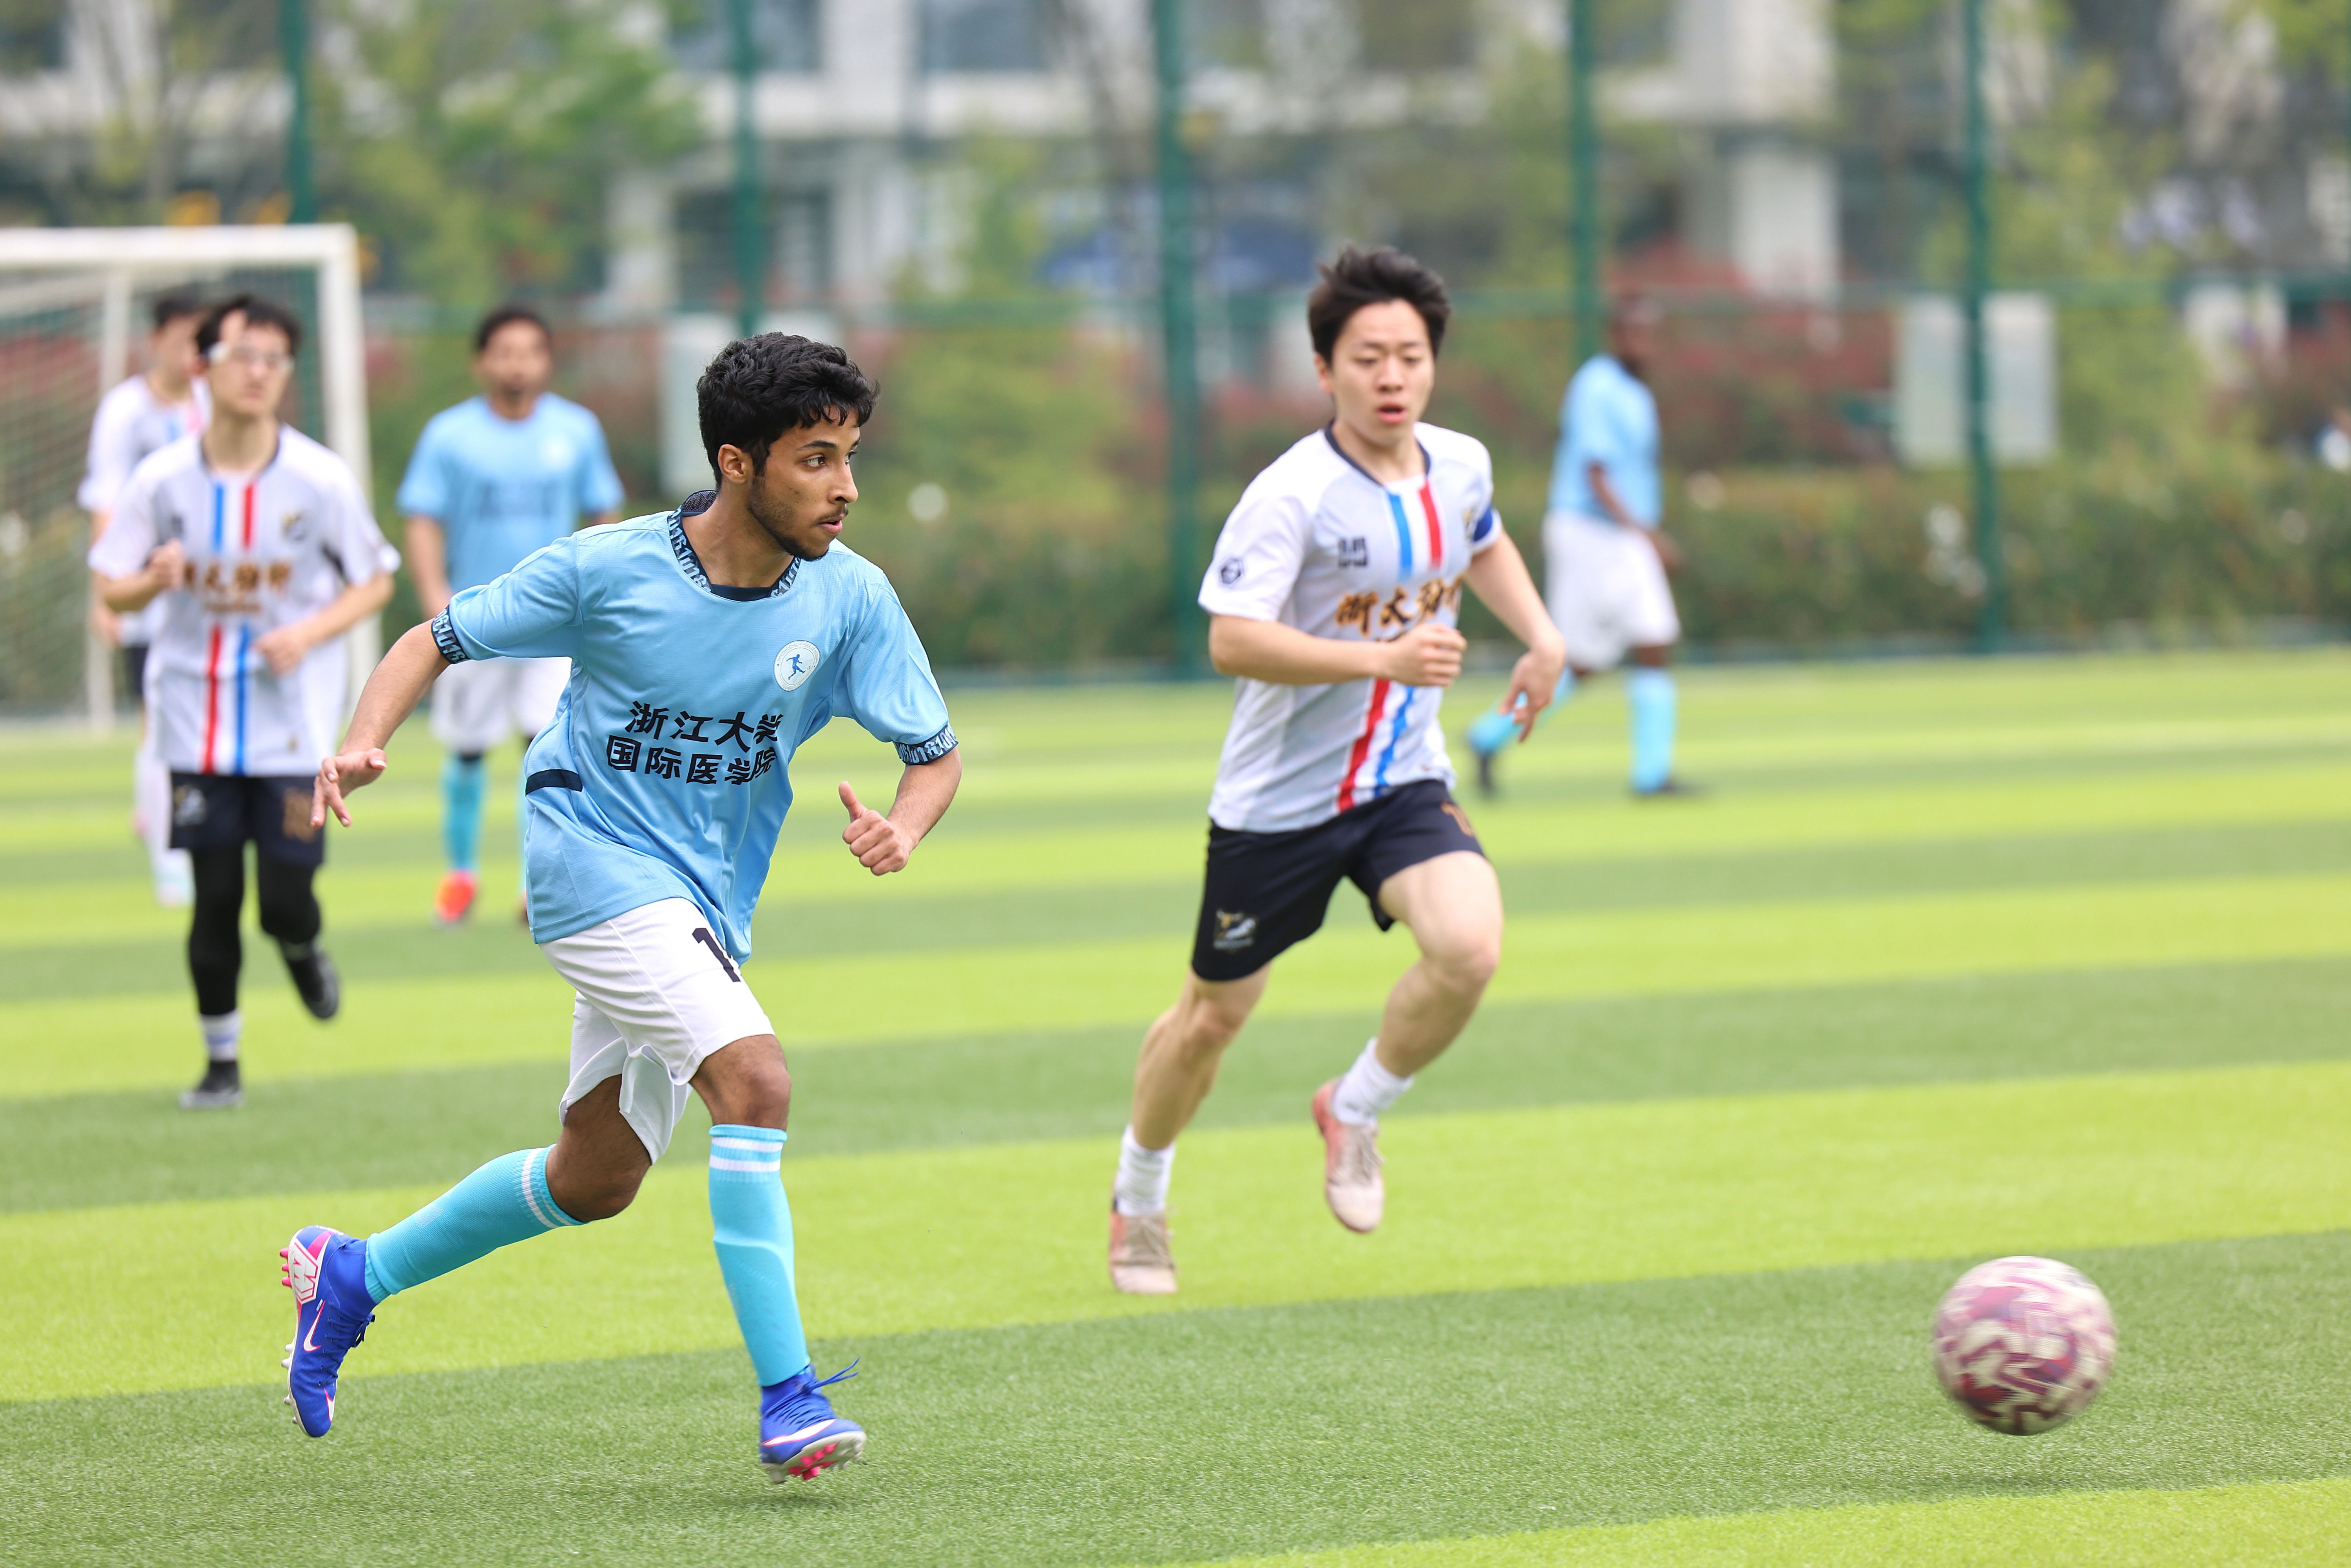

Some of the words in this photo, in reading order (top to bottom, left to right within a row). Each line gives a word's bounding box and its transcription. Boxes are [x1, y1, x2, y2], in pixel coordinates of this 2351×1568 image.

[777, 643, 797, 661] INTERNATIONAL
[625, 701, 783, 752] 浙江大学
[607, 735, 778, 785] 国际医学院
[692, 927, 741, 982] 1
